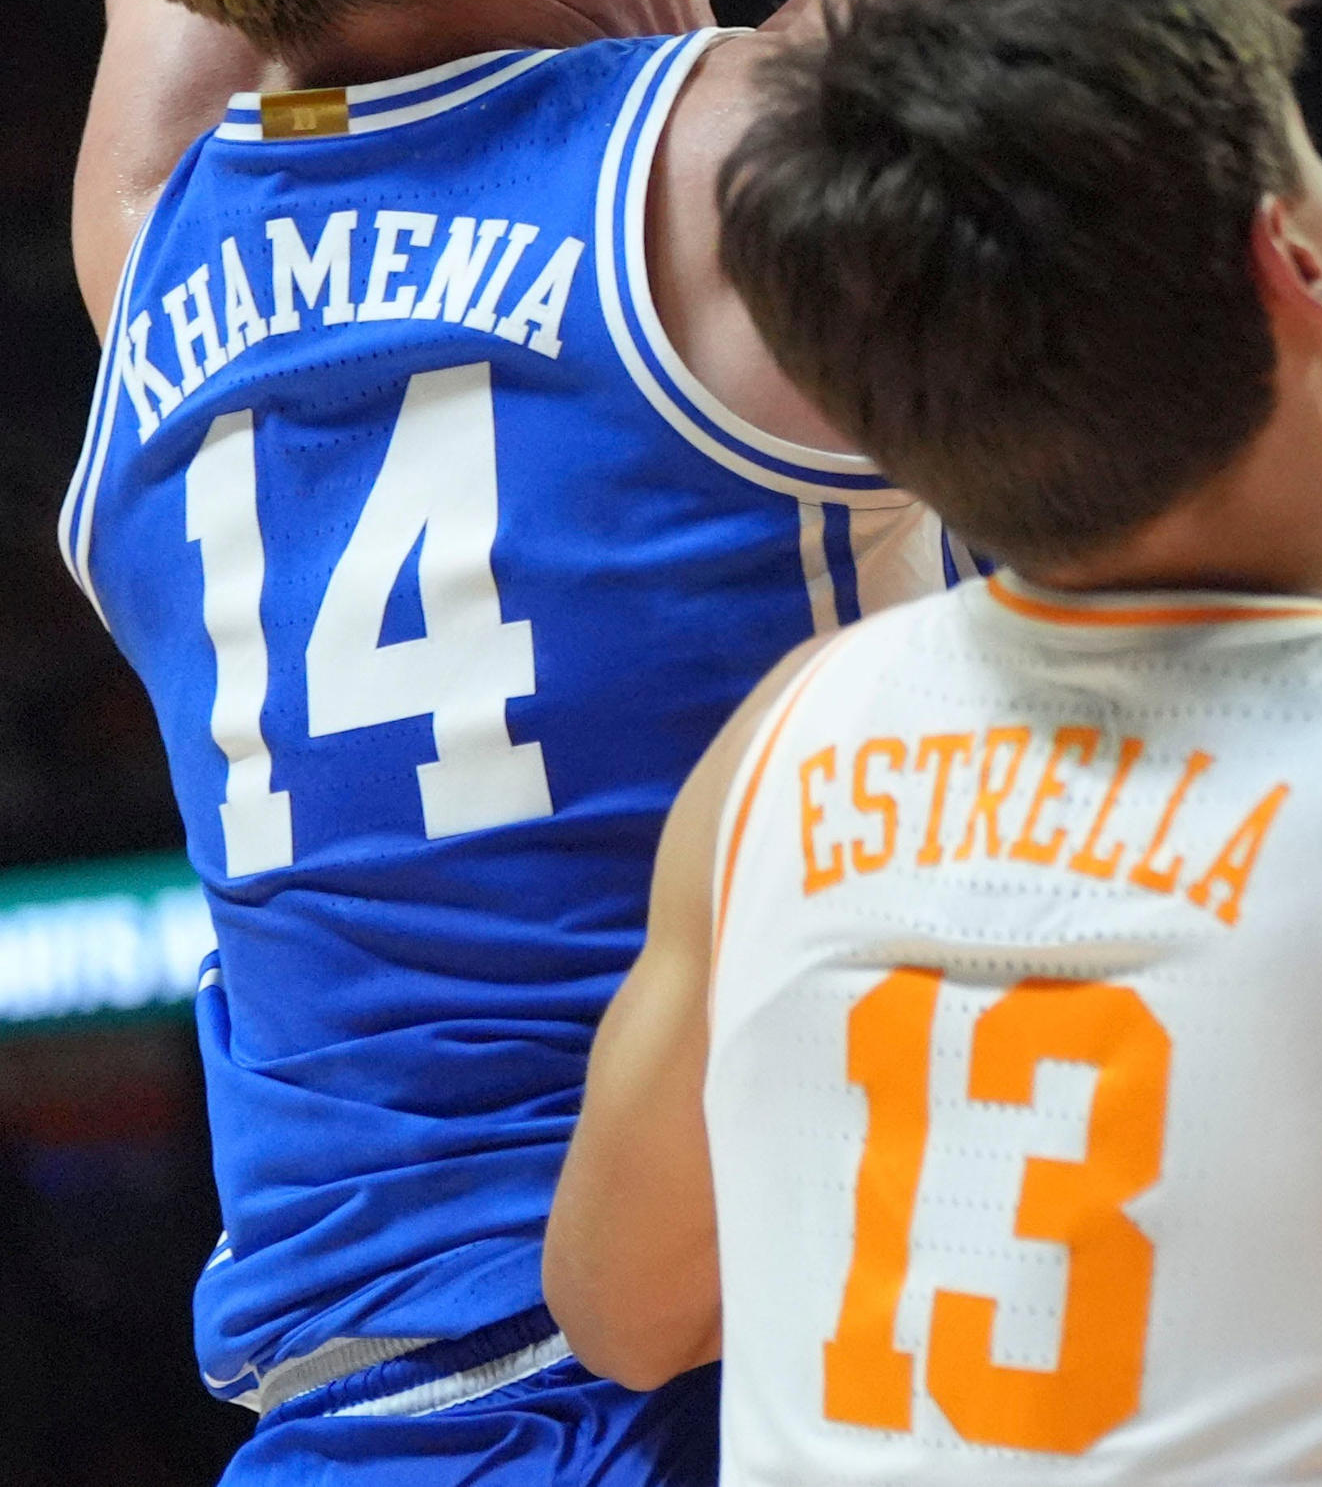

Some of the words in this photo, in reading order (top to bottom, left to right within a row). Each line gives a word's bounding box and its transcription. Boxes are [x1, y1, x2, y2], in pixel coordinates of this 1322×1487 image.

[121, 210, 585, 445] KHAMENIA
[186, 361, 554, 878] 14
[800, 725, 1289, 927] ESTRELLA
[823, 963, 1171, 1454] 13
